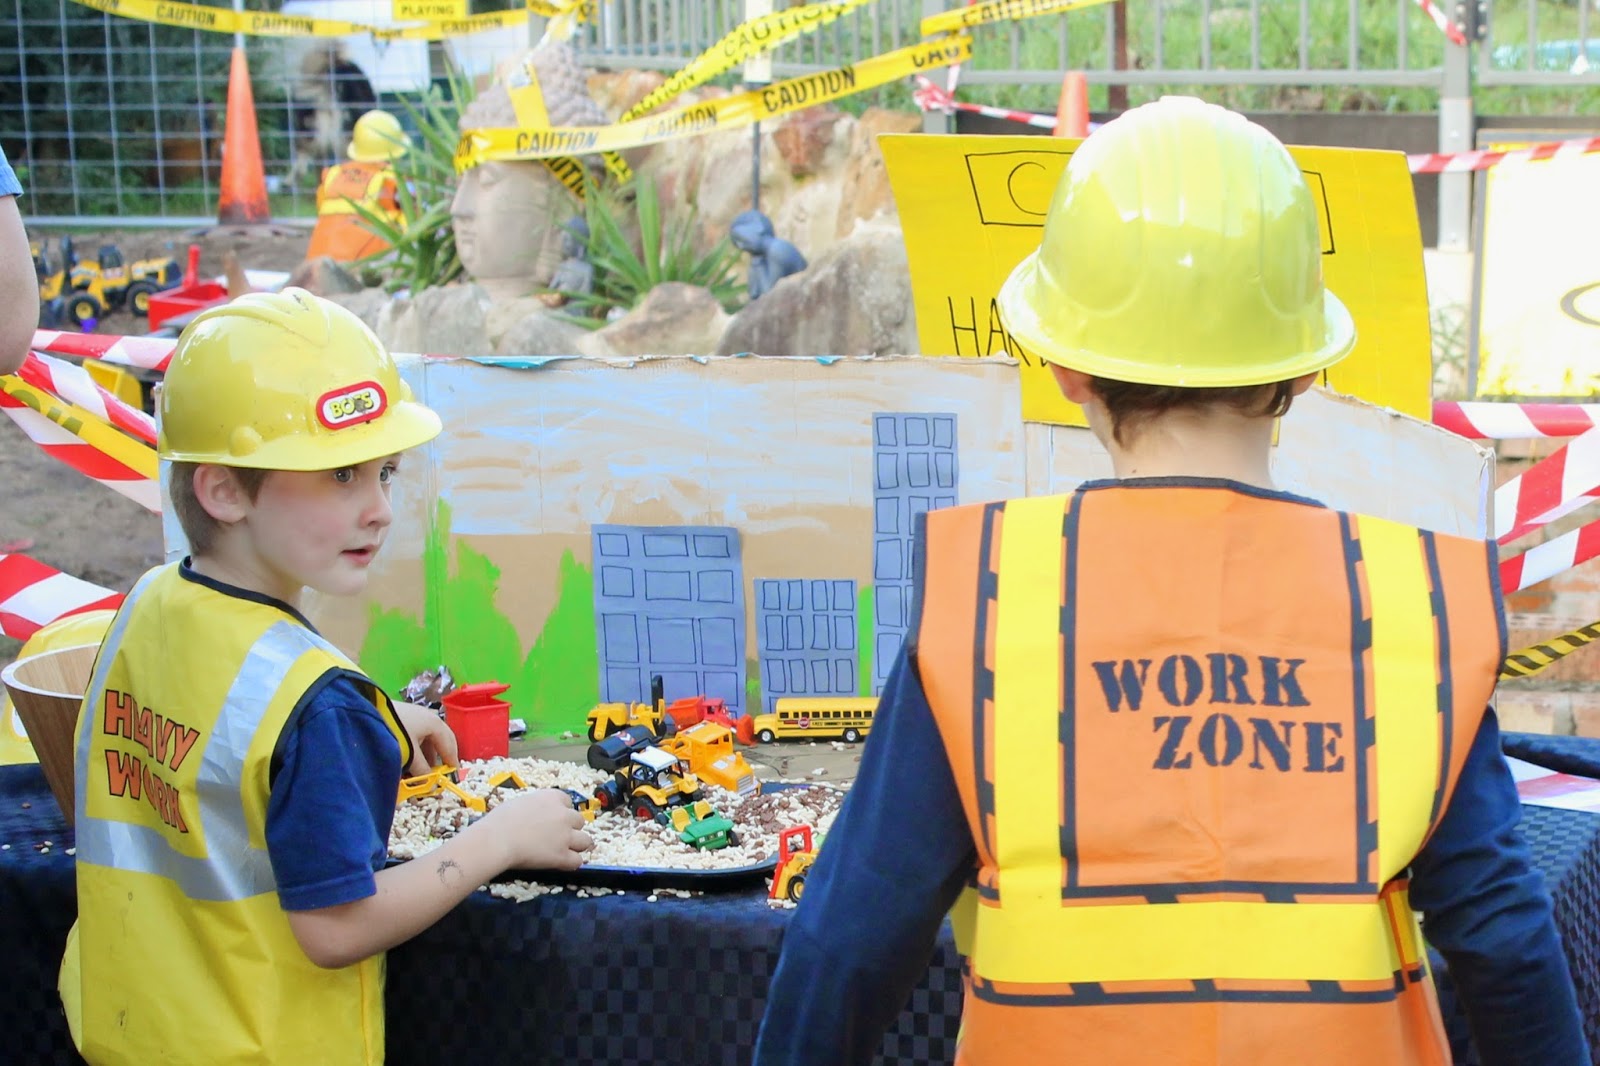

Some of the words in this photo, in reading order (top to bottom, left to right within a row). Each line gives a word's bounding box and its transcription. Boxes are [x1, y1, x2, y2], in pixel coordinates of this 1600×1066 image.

[156, 4, 216, 26] CAUTION
[252, 16, 313, 34] CAUTION
[440, 17, 504, 33] CAUTION
[762, 66, 856, 112] CAUTION
[516, 131, 599, 155] CAUTION
[1091, 652, 1311, 713] WORK
[1152, 713, 1345, 773] ZONE
